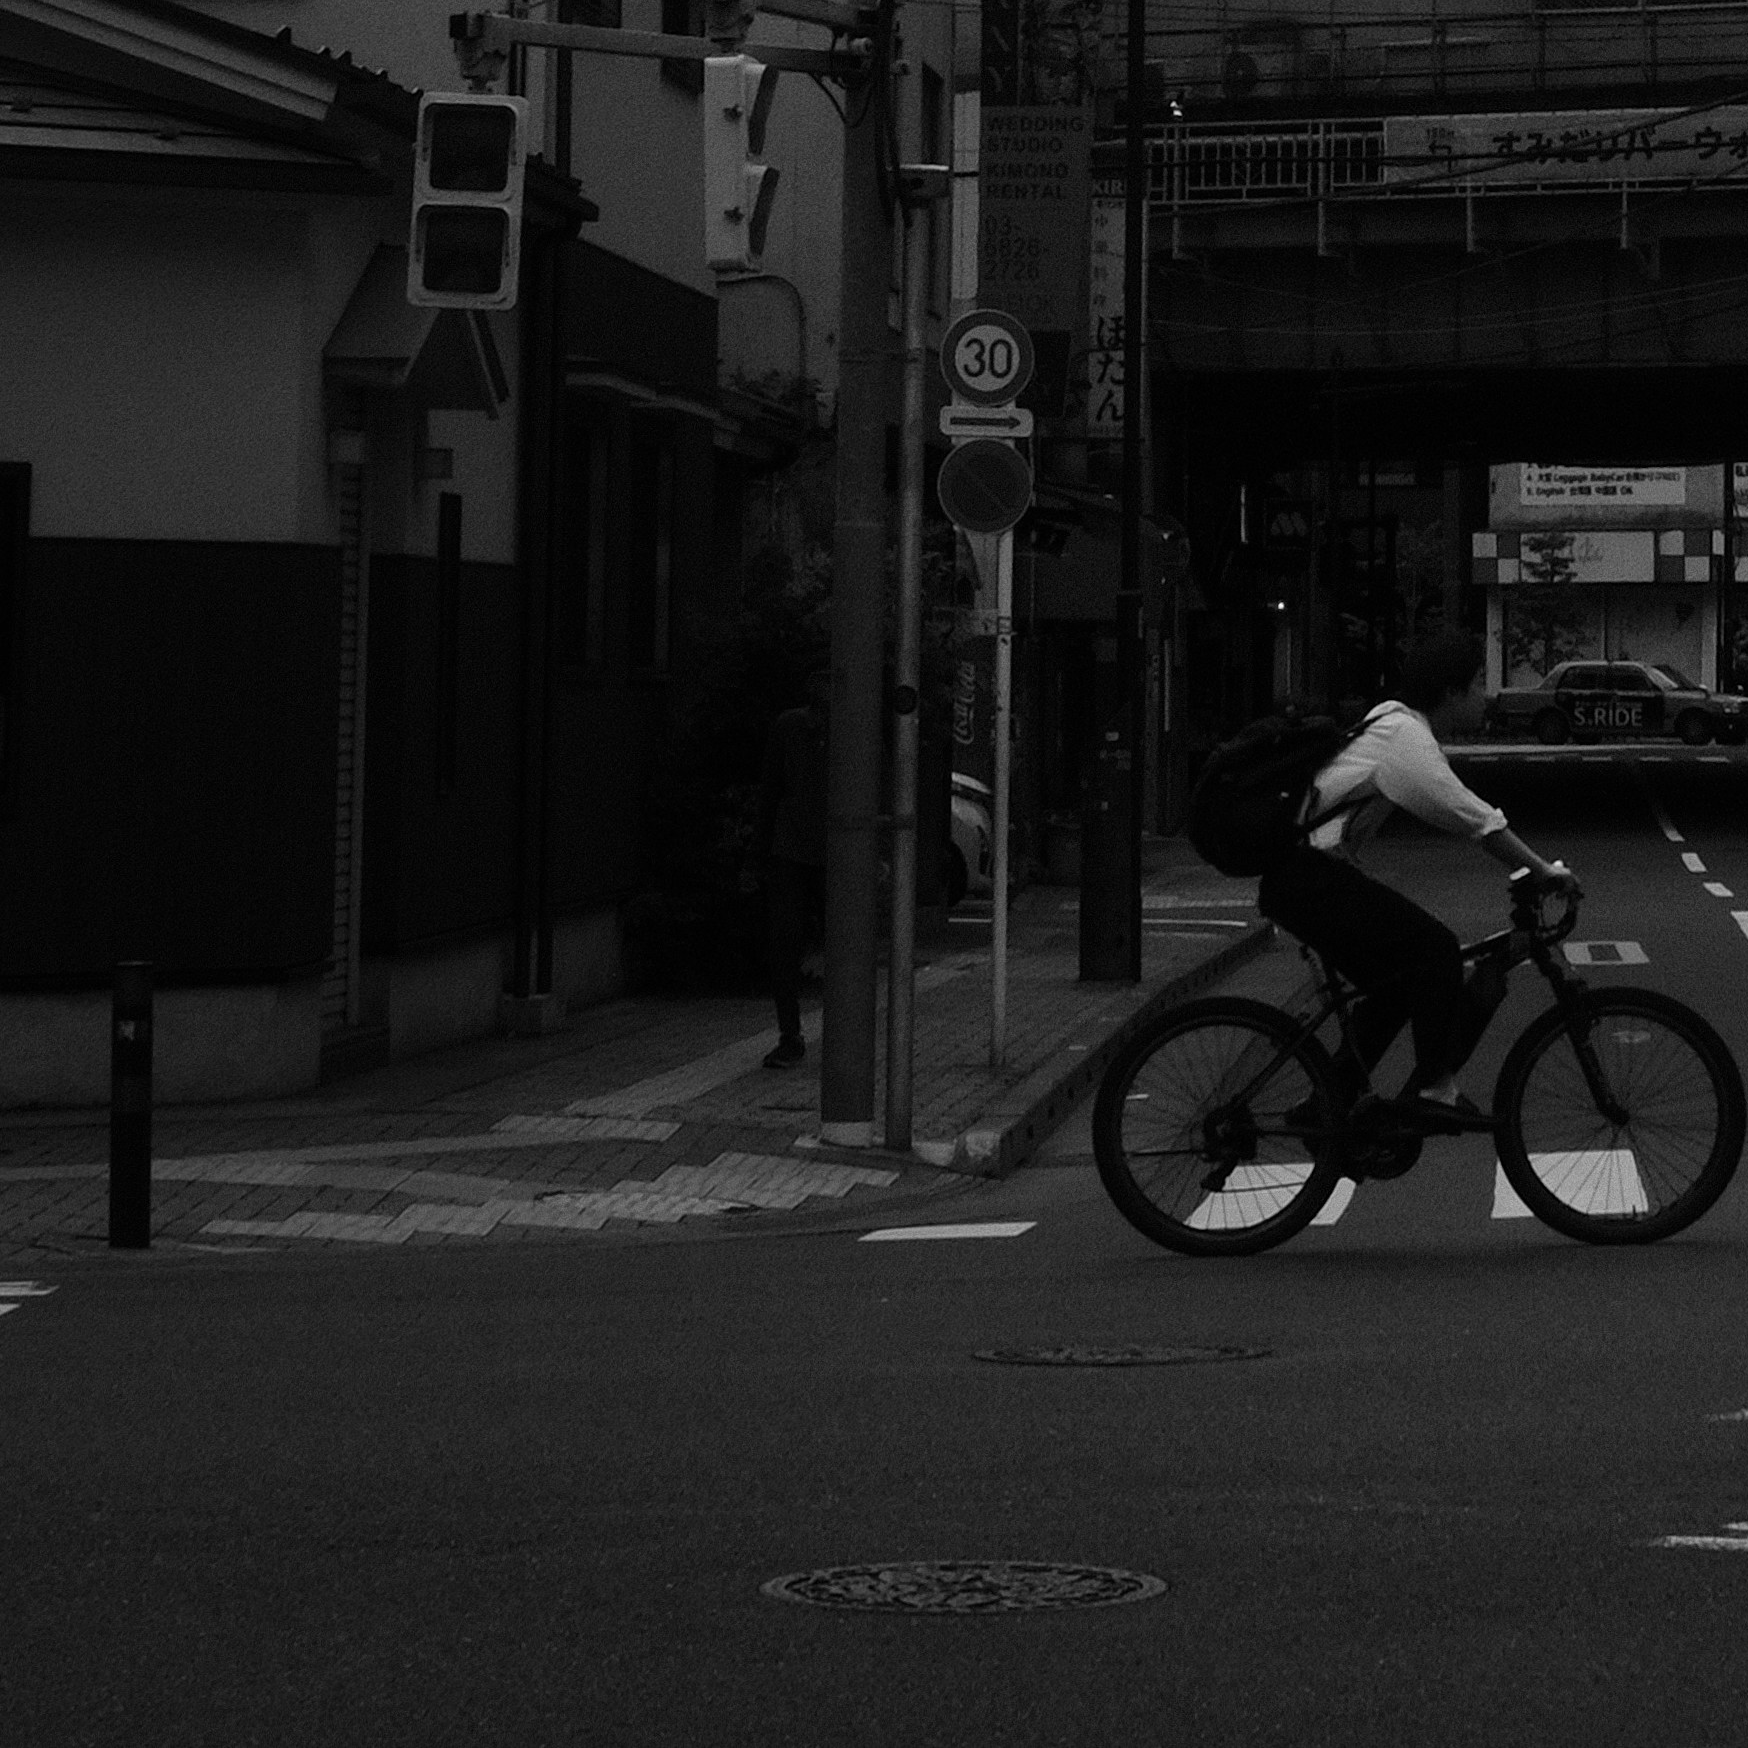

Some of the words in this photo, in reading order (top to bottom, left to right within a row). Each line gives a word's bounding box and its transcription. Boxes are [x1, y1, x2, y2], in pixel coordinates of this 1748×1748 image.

[988, 117, 1085, 132] WEDDING
[987, 137, 1065, 153] STUDIO
[986, 162, 1070, 179] KIMONO
[986, 183, 1067, 200] RENTAL
[963, 338, 1014, 379] 30
[1573, 707, 1643, 728] S.RIDE
